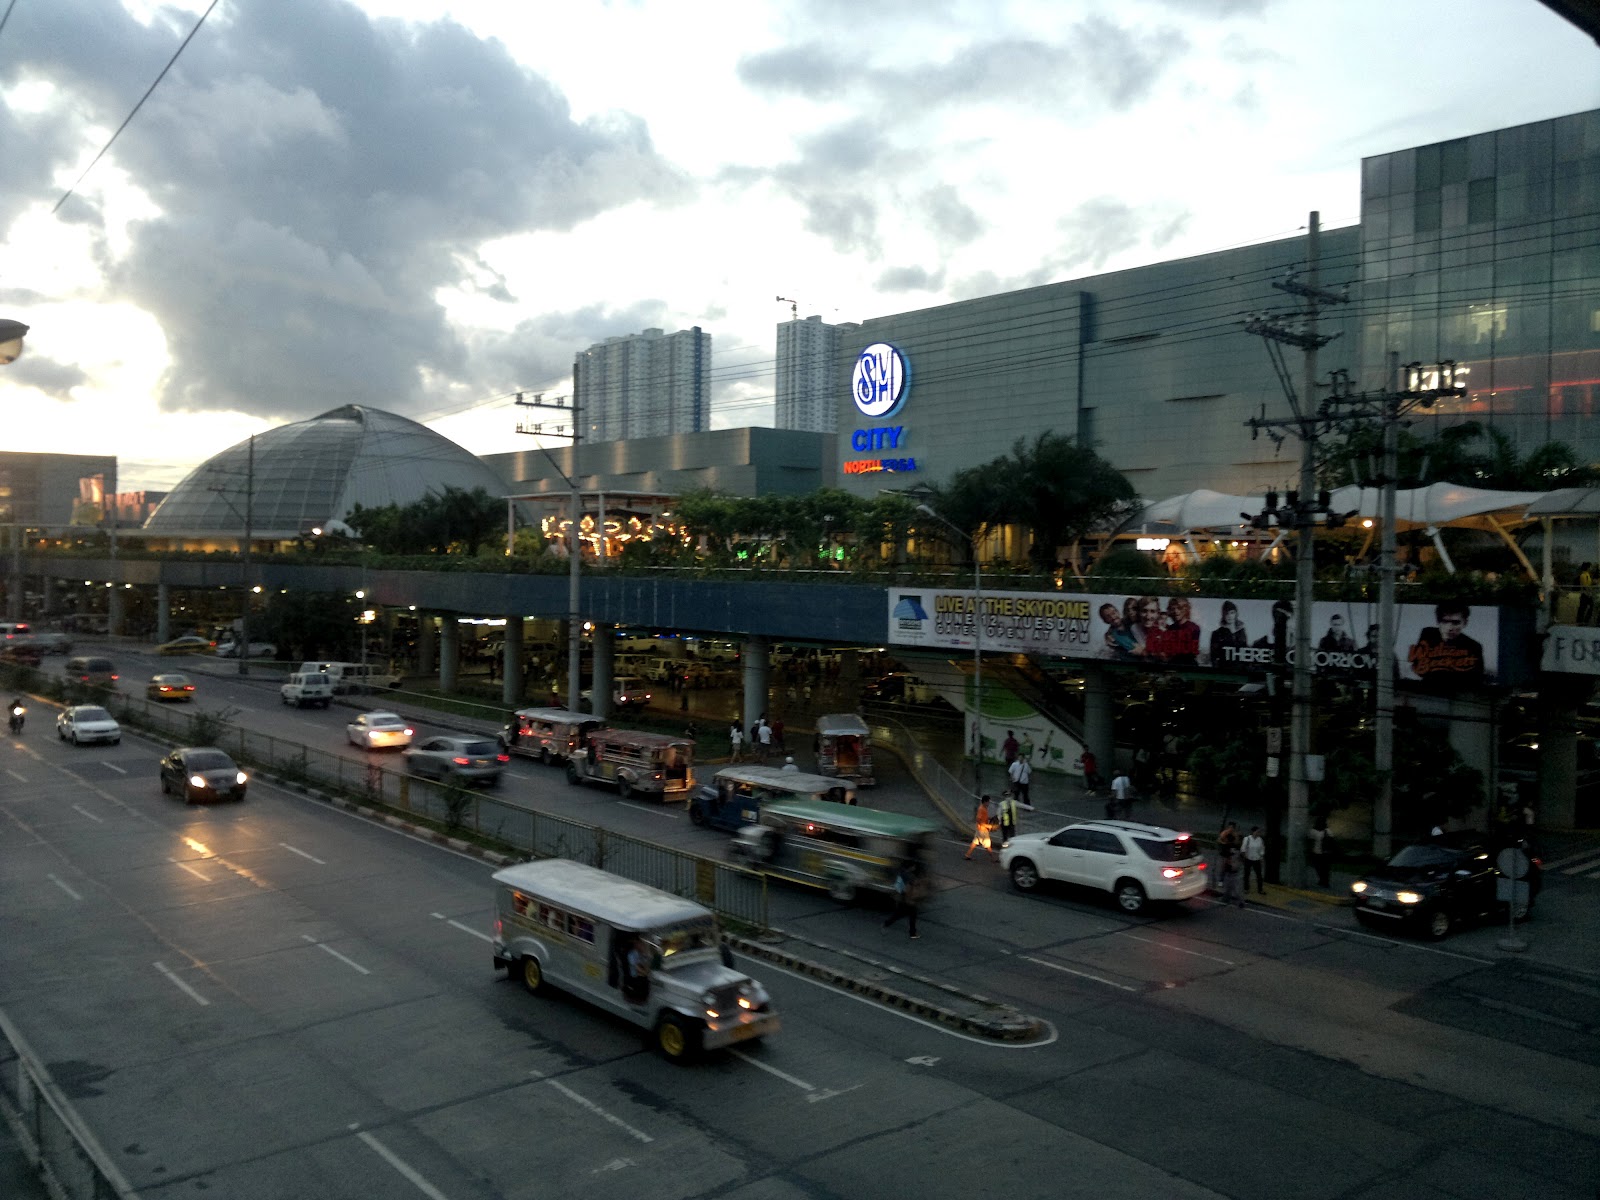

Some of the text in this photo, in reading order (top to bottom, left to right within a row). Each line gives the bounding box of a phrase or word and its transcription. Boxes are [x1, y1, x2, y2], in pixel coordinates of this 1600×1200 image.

[857, 350, 896, 405] SM
[851, 425, 904, 452] CITY
[935, 596, 964, 613] LIVE
[984, 598, 1013, 616] THE
[1015, 599, 1090, 620] SKYDOME
[935, 612, 974, 625] JUNE
[1012, 615, 1090, 632] TUESDAY
[935, 624, 977, 636] GATES
[986, 626, 1025, 639] OPEN
[1032, 630, 1051, 640] AT
[1058, 631, 1090, 644] 7PM
